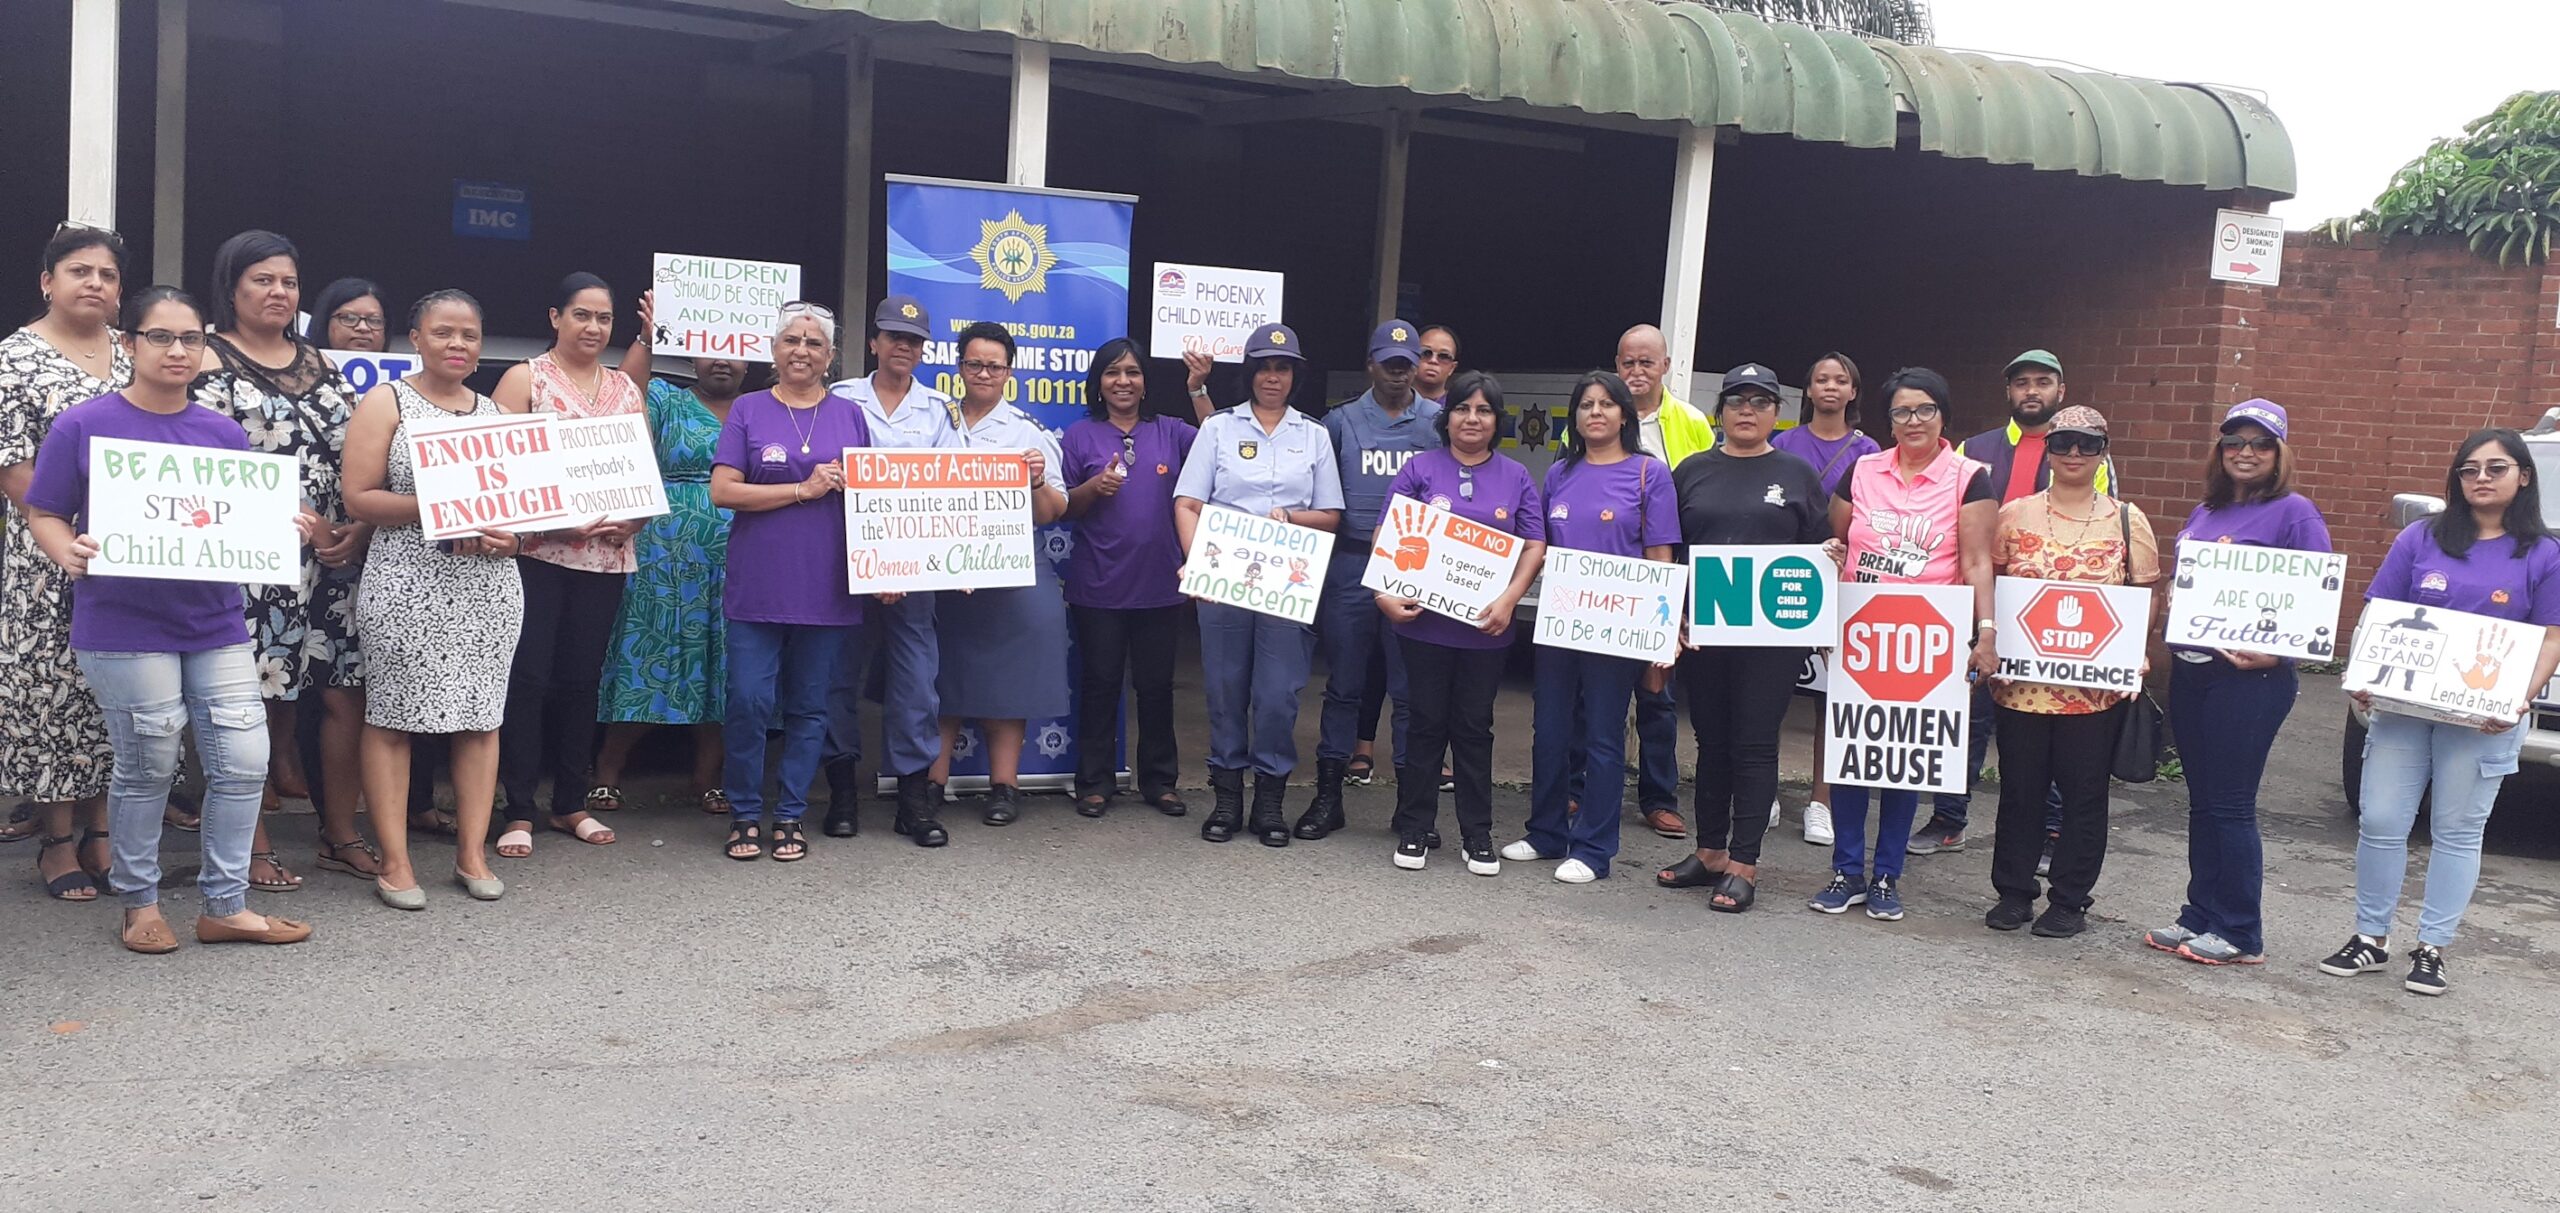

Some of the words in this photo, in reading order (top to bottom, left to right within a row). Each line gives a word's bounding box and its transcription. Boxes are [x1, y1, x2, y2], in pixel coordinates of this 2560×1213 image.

[468, 208, 517, 228] IMC
[2242, 227, 2279, 239] DESIGNATED
[2246, 237, 2274, 248] SMOKING
[2251, 248, 2267, 256] AREA
[725, 285, 743, 303] BE
[750, 287, 785, 308] SEEN
[1196, 282, 1265, 306] PHOENIX
[678, 308, 724, 323] AND
[730, 312, 776, 329] NOT
[1157, 306, 1201, 325] CHILD
[1205, 310, 1267, 329] WELFARE
[1183, 335, 1209, 354] We
[1213, 336, 1243, 356] Care
[936, 372, 1018, 402] 080
[1025, 377, 1088, 405] 10111
[416, 427, 550, 468] ENOUGH
[559, 421, 637, 450] PROTECTION
[104, 449, 147, 481] BE
[158, 454, 181, 483] A
[193, 457, 280, 491] HERO
[475, 463, 508, 491] IS
[565, 456, 635, 480] verybody's
[855, 454, 872, 482] 16
[875, 454, 919, 488] Days
[924, 455, 941, 482] of
[947, 454, 1020, 482] Activism
[429, 485, 564, 530] ENOUGH
[854, 492, 892, 513] Lets
[899, 491, 942, 512] unite
[948, 491, 978, 512] and
[984, 490, 1026, 511] END
[981, 520, 1025, 540] against
[1453, 523, 1483, 544] SAY
[1483, 534, 1507, 553] NO
[103, 533, 185, 566] Child
[195, 538, 280, 571] Abuse
[851, 549, 921, 580] Women
[926, 554, 941, 571] &
[946, 543, 1032, 575] Children
[1858, 552, 1907, 576] BREAK
[1889, 548, 1929, 561] STOP
[2196, 548, 2324, 577] CHILDREN
[1441, 554, 1453, 566] to
[1456, 560, 1497, 580] gender
[1772, 568, 1812, 578] EXCUSE
[1446, 570, 1482, 591] based
[1782, 582, 1802, 592] FOR
[1383, 575, 1478, 621] VIOLENCE
[1777, 596, 1807, 605] CHILD
[2213, 589, 2249, 608] ARE
[2255, 592, 2295, 610] OUR
[1775, 609, 1808, 619] ABUSE
[1544, 616, 1565, 637] TO
[1601, 626, 1612, 644] a
[2041, 629, 2094, 649] STOP
[2187, 615, 2308, 647] Future
[2380, 628, 2420, 647] Take
[2424, 639, 2435, 650] a
[1847, 621, 1949, 675] STOP
[2367, 645, 2435, 668] STAND
[1997, 657, 2031, 677] THE
[2036, 660, 2135, 686] VIOLENCE
[2430, 683, 2467, 706] Lend
[2467, 695, 2476, 708] a
[2477, 691, 2512, 716] hand
[1832, 702, 1961, 748] WOMEN
[1839, 743, 1943, 787] ABUSE
